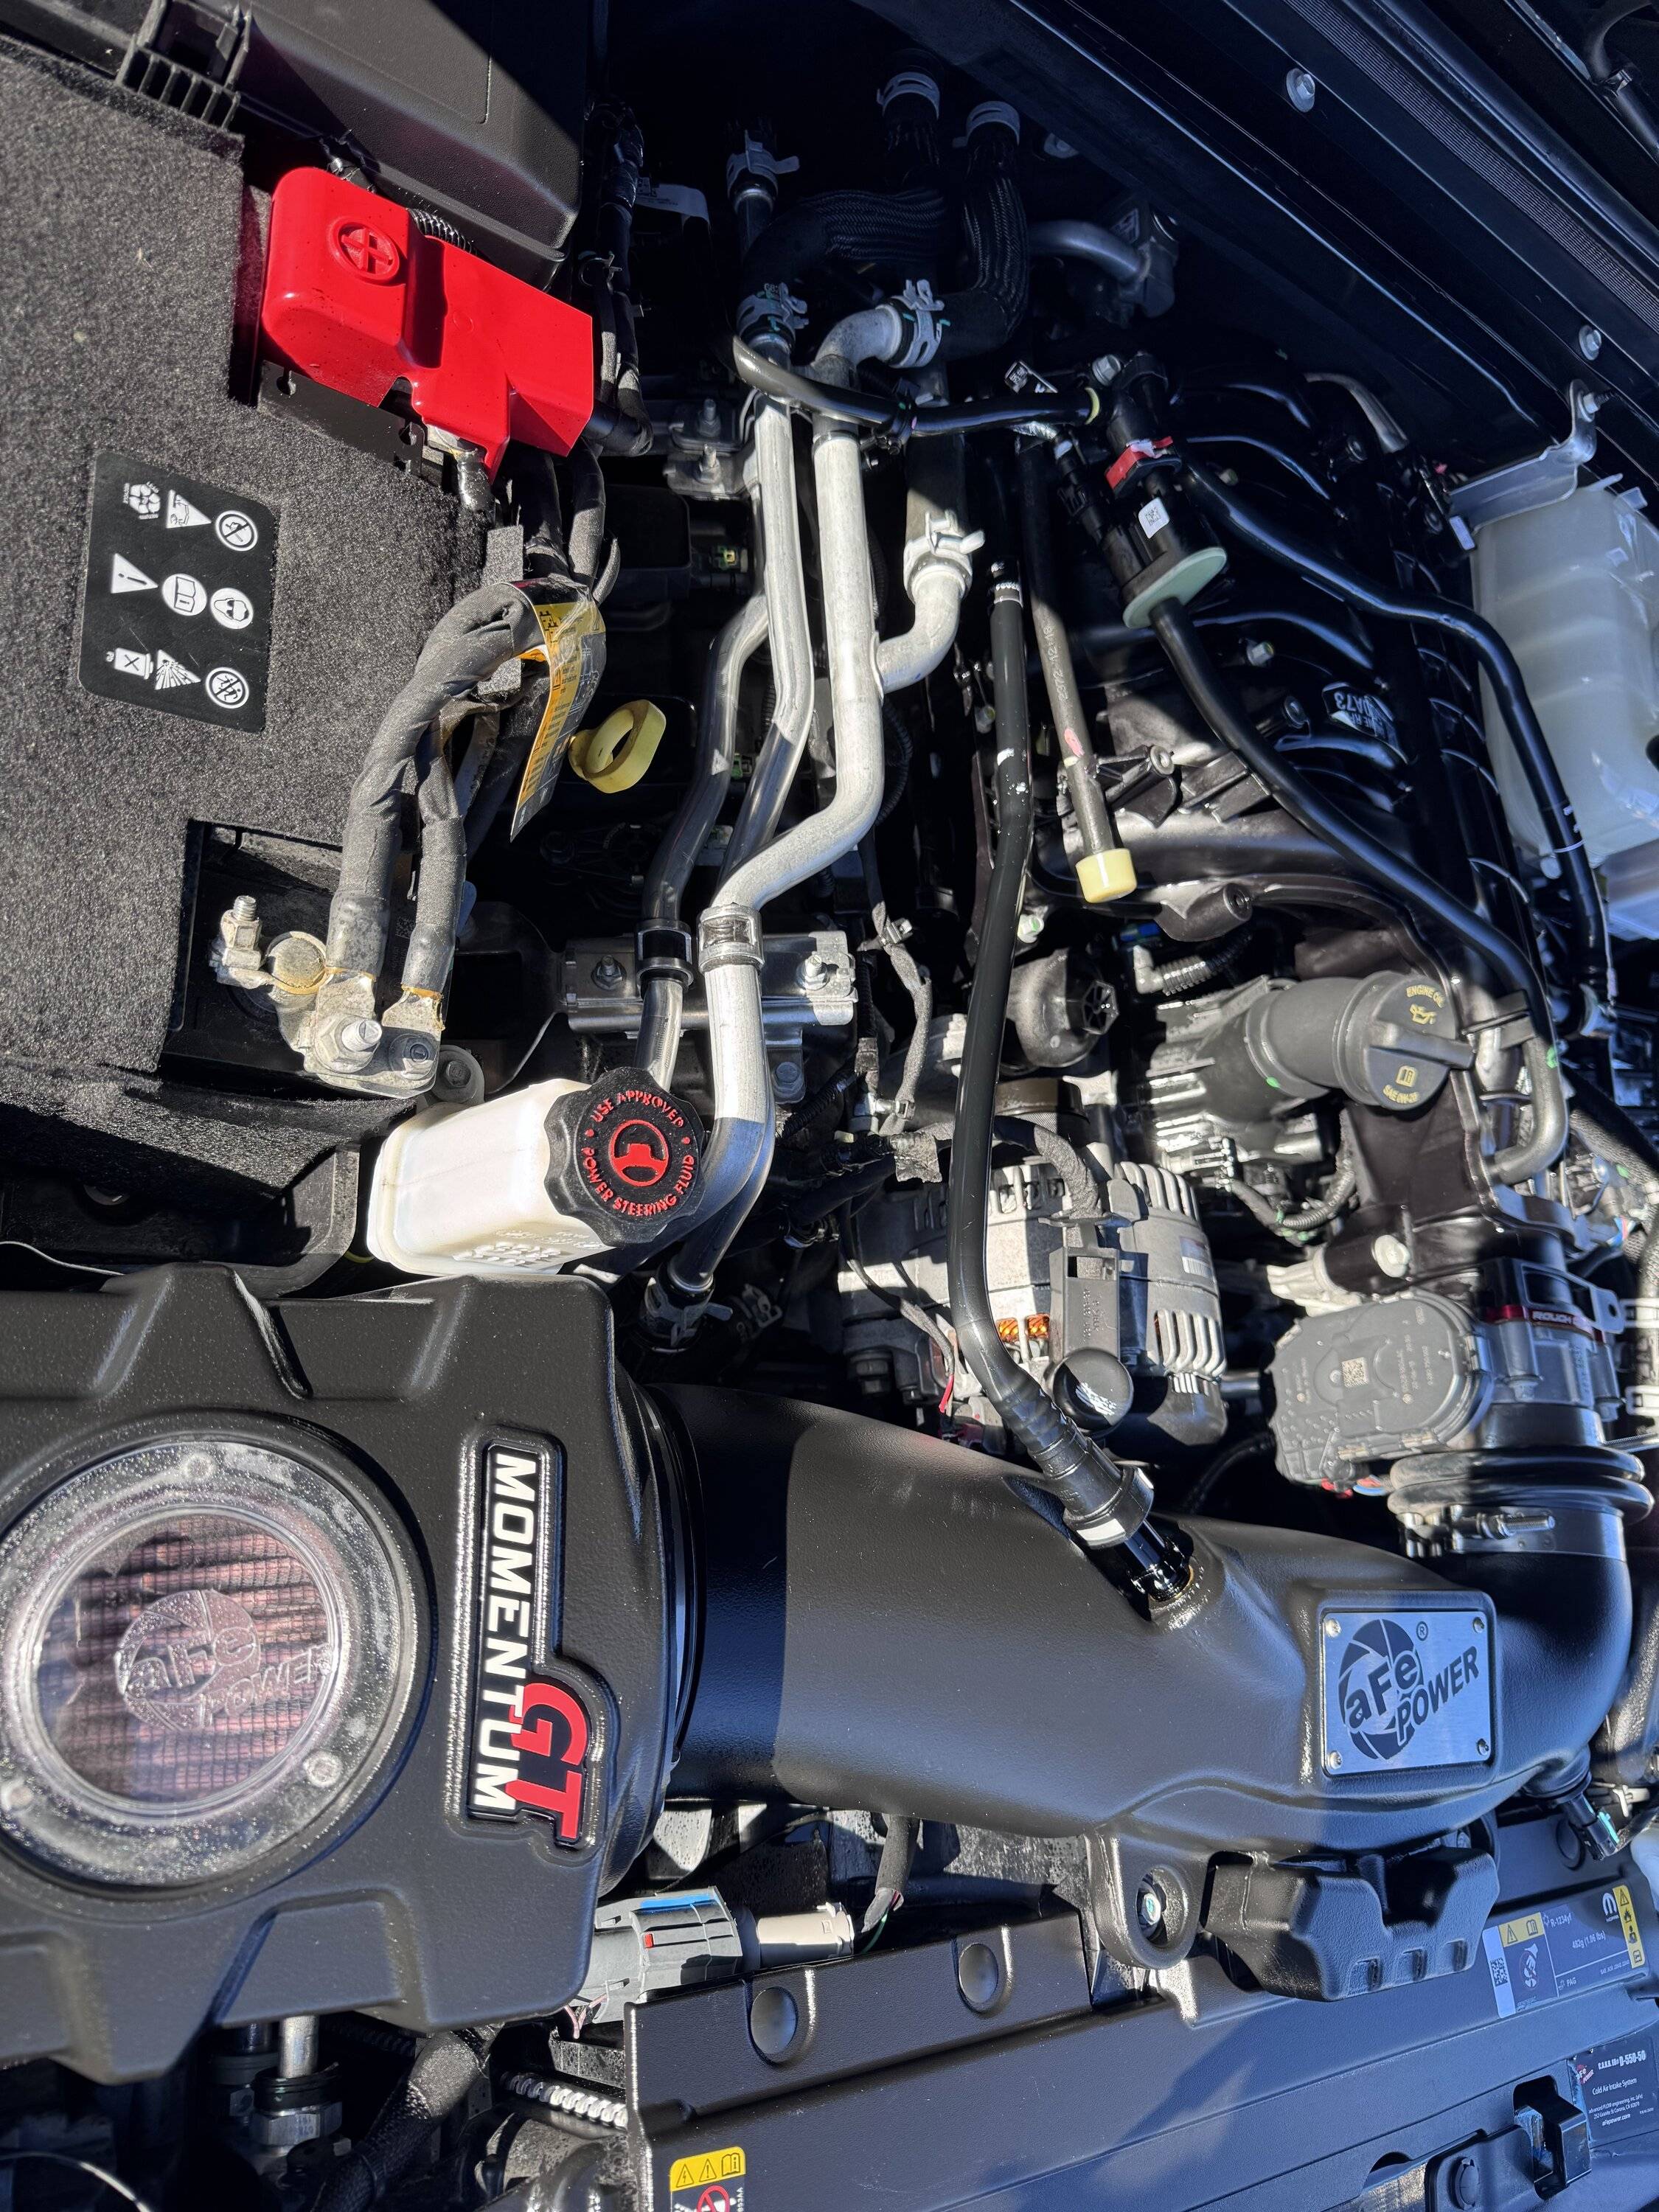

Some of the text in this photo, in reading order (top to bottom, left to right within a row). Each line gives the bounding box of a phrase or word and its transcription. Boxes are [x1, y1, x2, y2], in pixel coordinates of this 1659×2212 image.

[590, 1089, 685, 1128] USE APPROVED
[581, 1146, 695, 1217] POWER STEERING FLUID
[473, 1453, 538, 1812] MOMENTUM
[1346, 1653, 1419, 1729] aFe
[1396, 1645, 1480, 1743] POWER
[504, 1682, 588, 1840] GT
[1566, 1977, 1576, 1988] PAG
[1592, 2087, 1603, 2096] Cold
[1609, 2081, 1622, 2091] Intake
[1622, 2078, 1638, 2089] System
